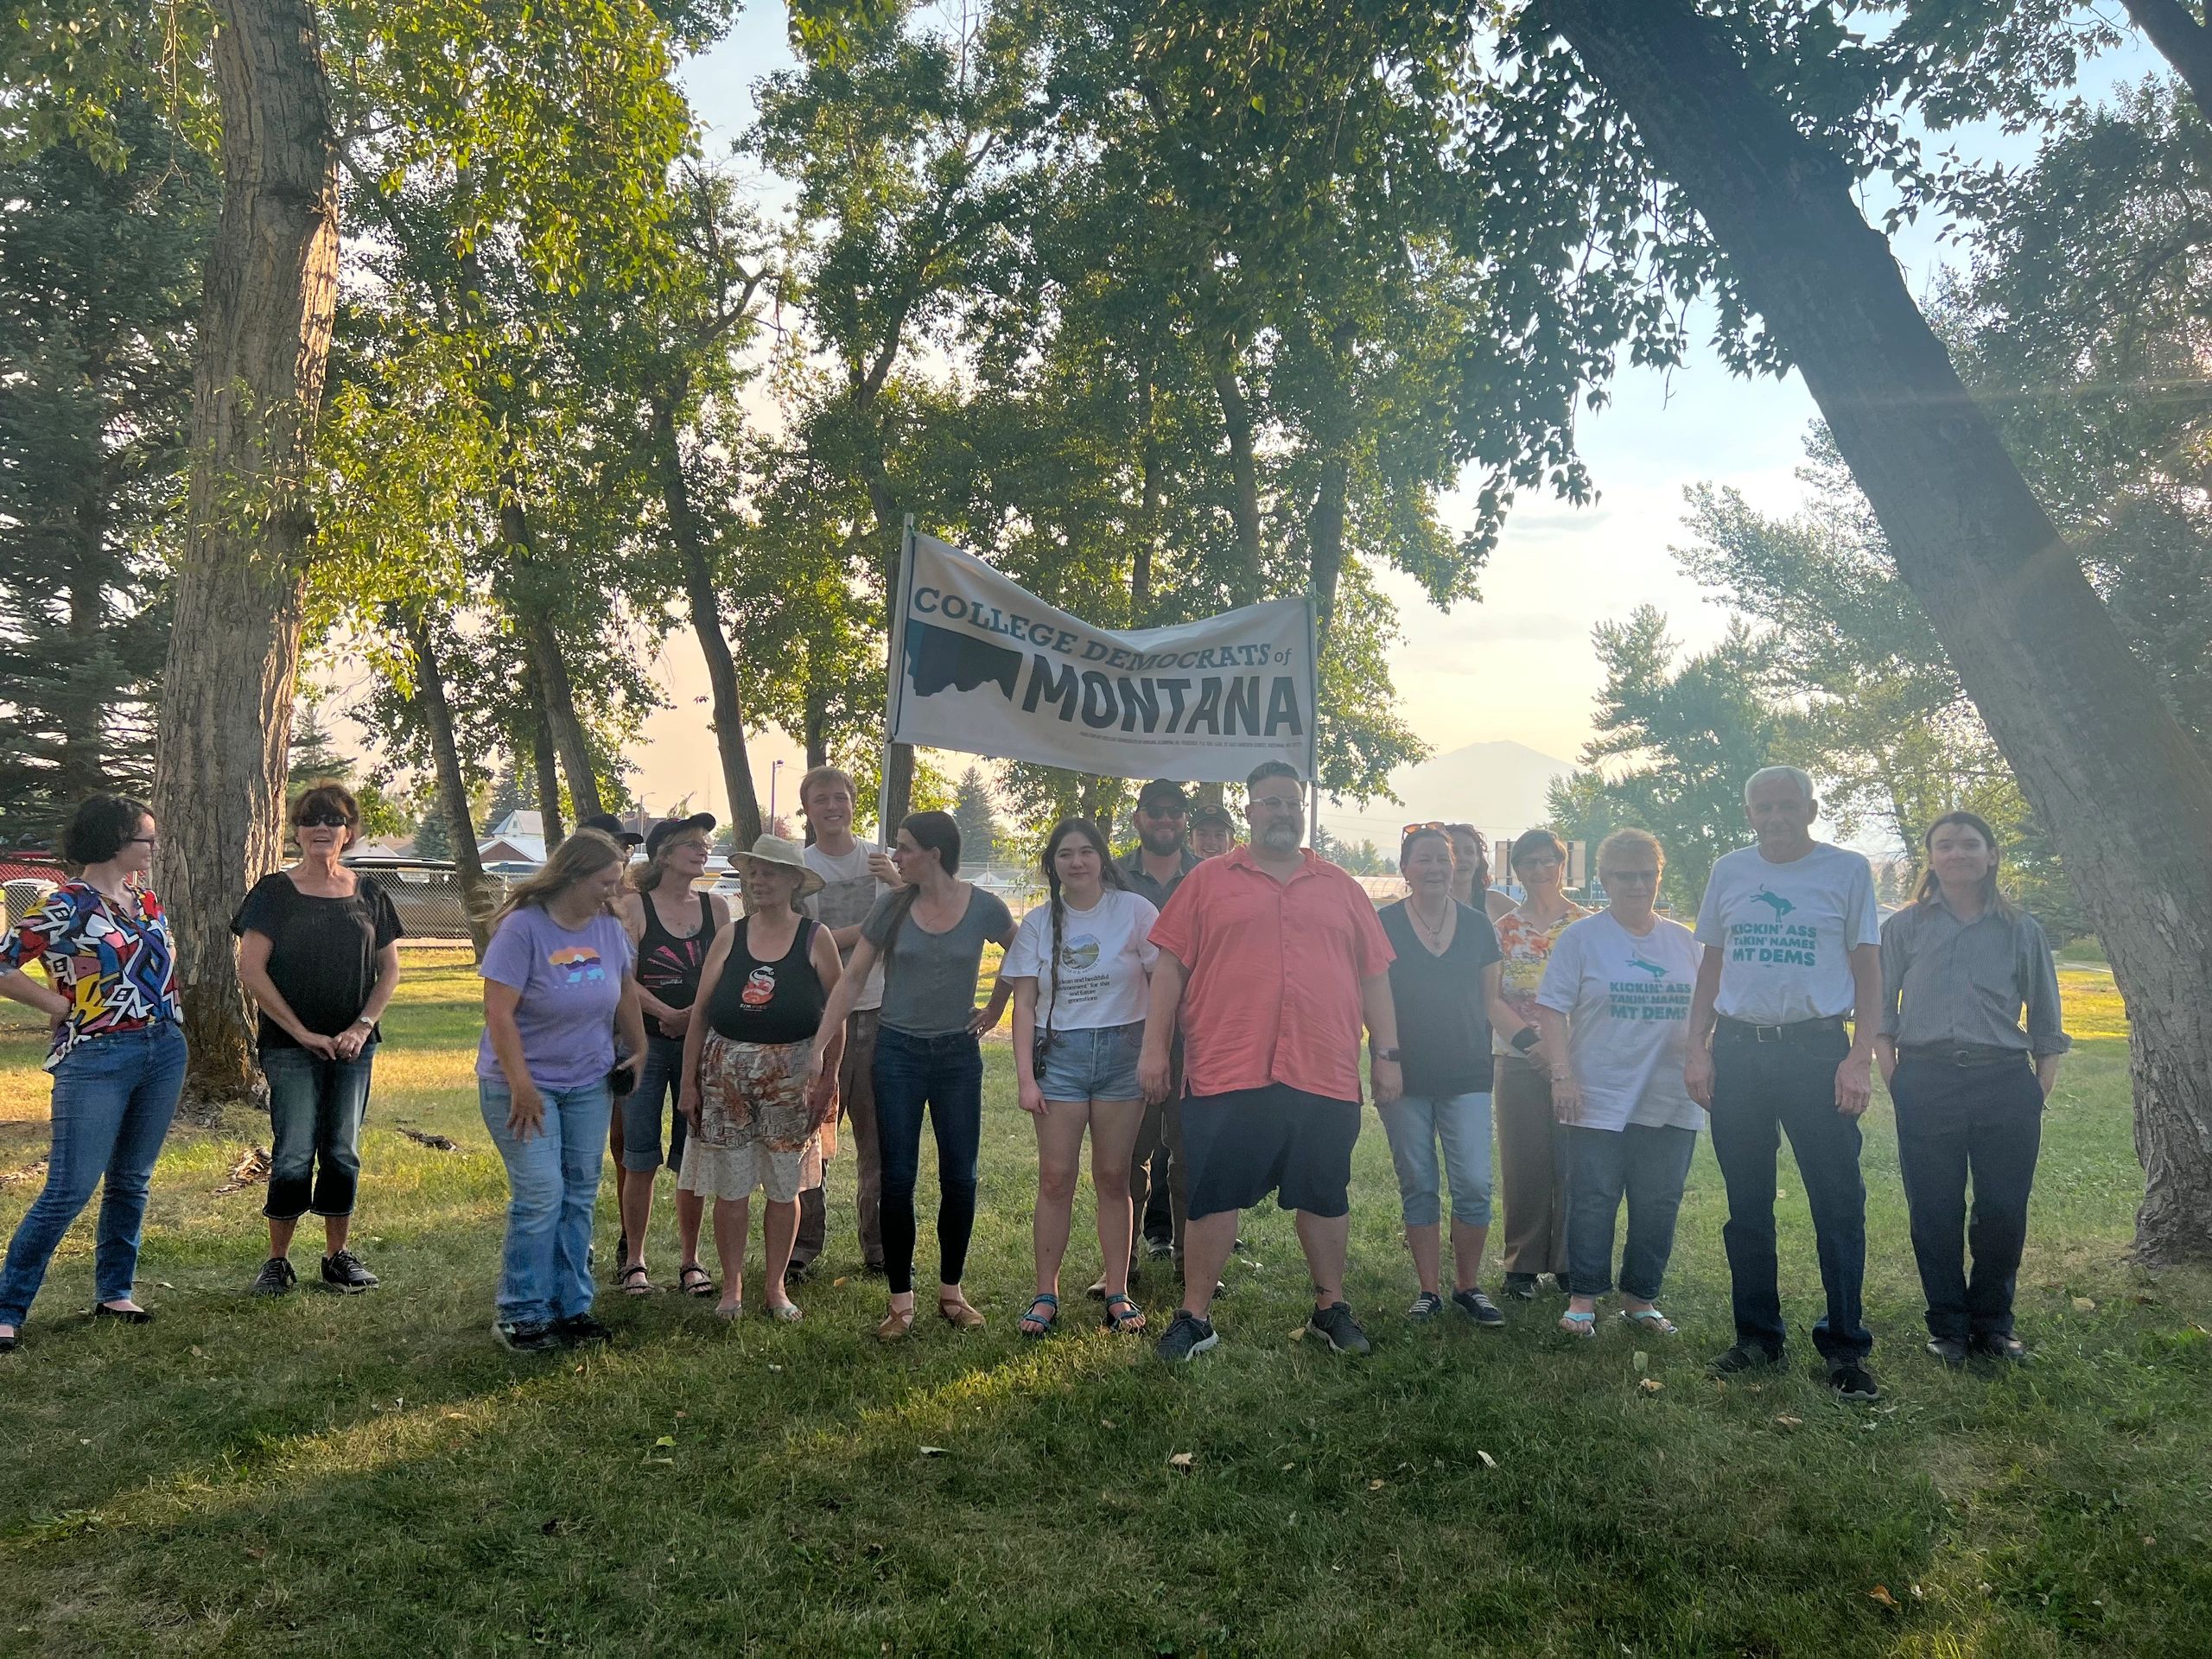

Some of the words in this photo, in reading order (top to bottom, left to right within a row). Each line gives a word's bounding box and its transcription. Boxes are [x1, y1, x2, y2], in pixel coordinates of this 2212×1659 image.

[914, 587, 1078, 655] COLLEGE
[1079, 639, 1272, 671] DEMOCRATS
[1273, 647, 1293, 666] of
[1021, 653, 1303, 737] MONTANA
[1731, 923, 1783, 935] KICKIN'
[1786, 925, 1818, 938] ASS
[1733, 936, 1768, 945] TAKIN'
[1770, 937, 1816, 950] NAMES
[1732, 948, 1756, 962] MT
[1759, 948, 1816, 967] DEMS
[1609, 982, 1662, 994] KICKIN'
[1665, 983, 1692, 994] ASS
[1609, 994, 1649, 1004] TAKIN'
[1610, 1005, 1639, 1020] MT
[1642, 1006, 1688, 1020] DEMS
